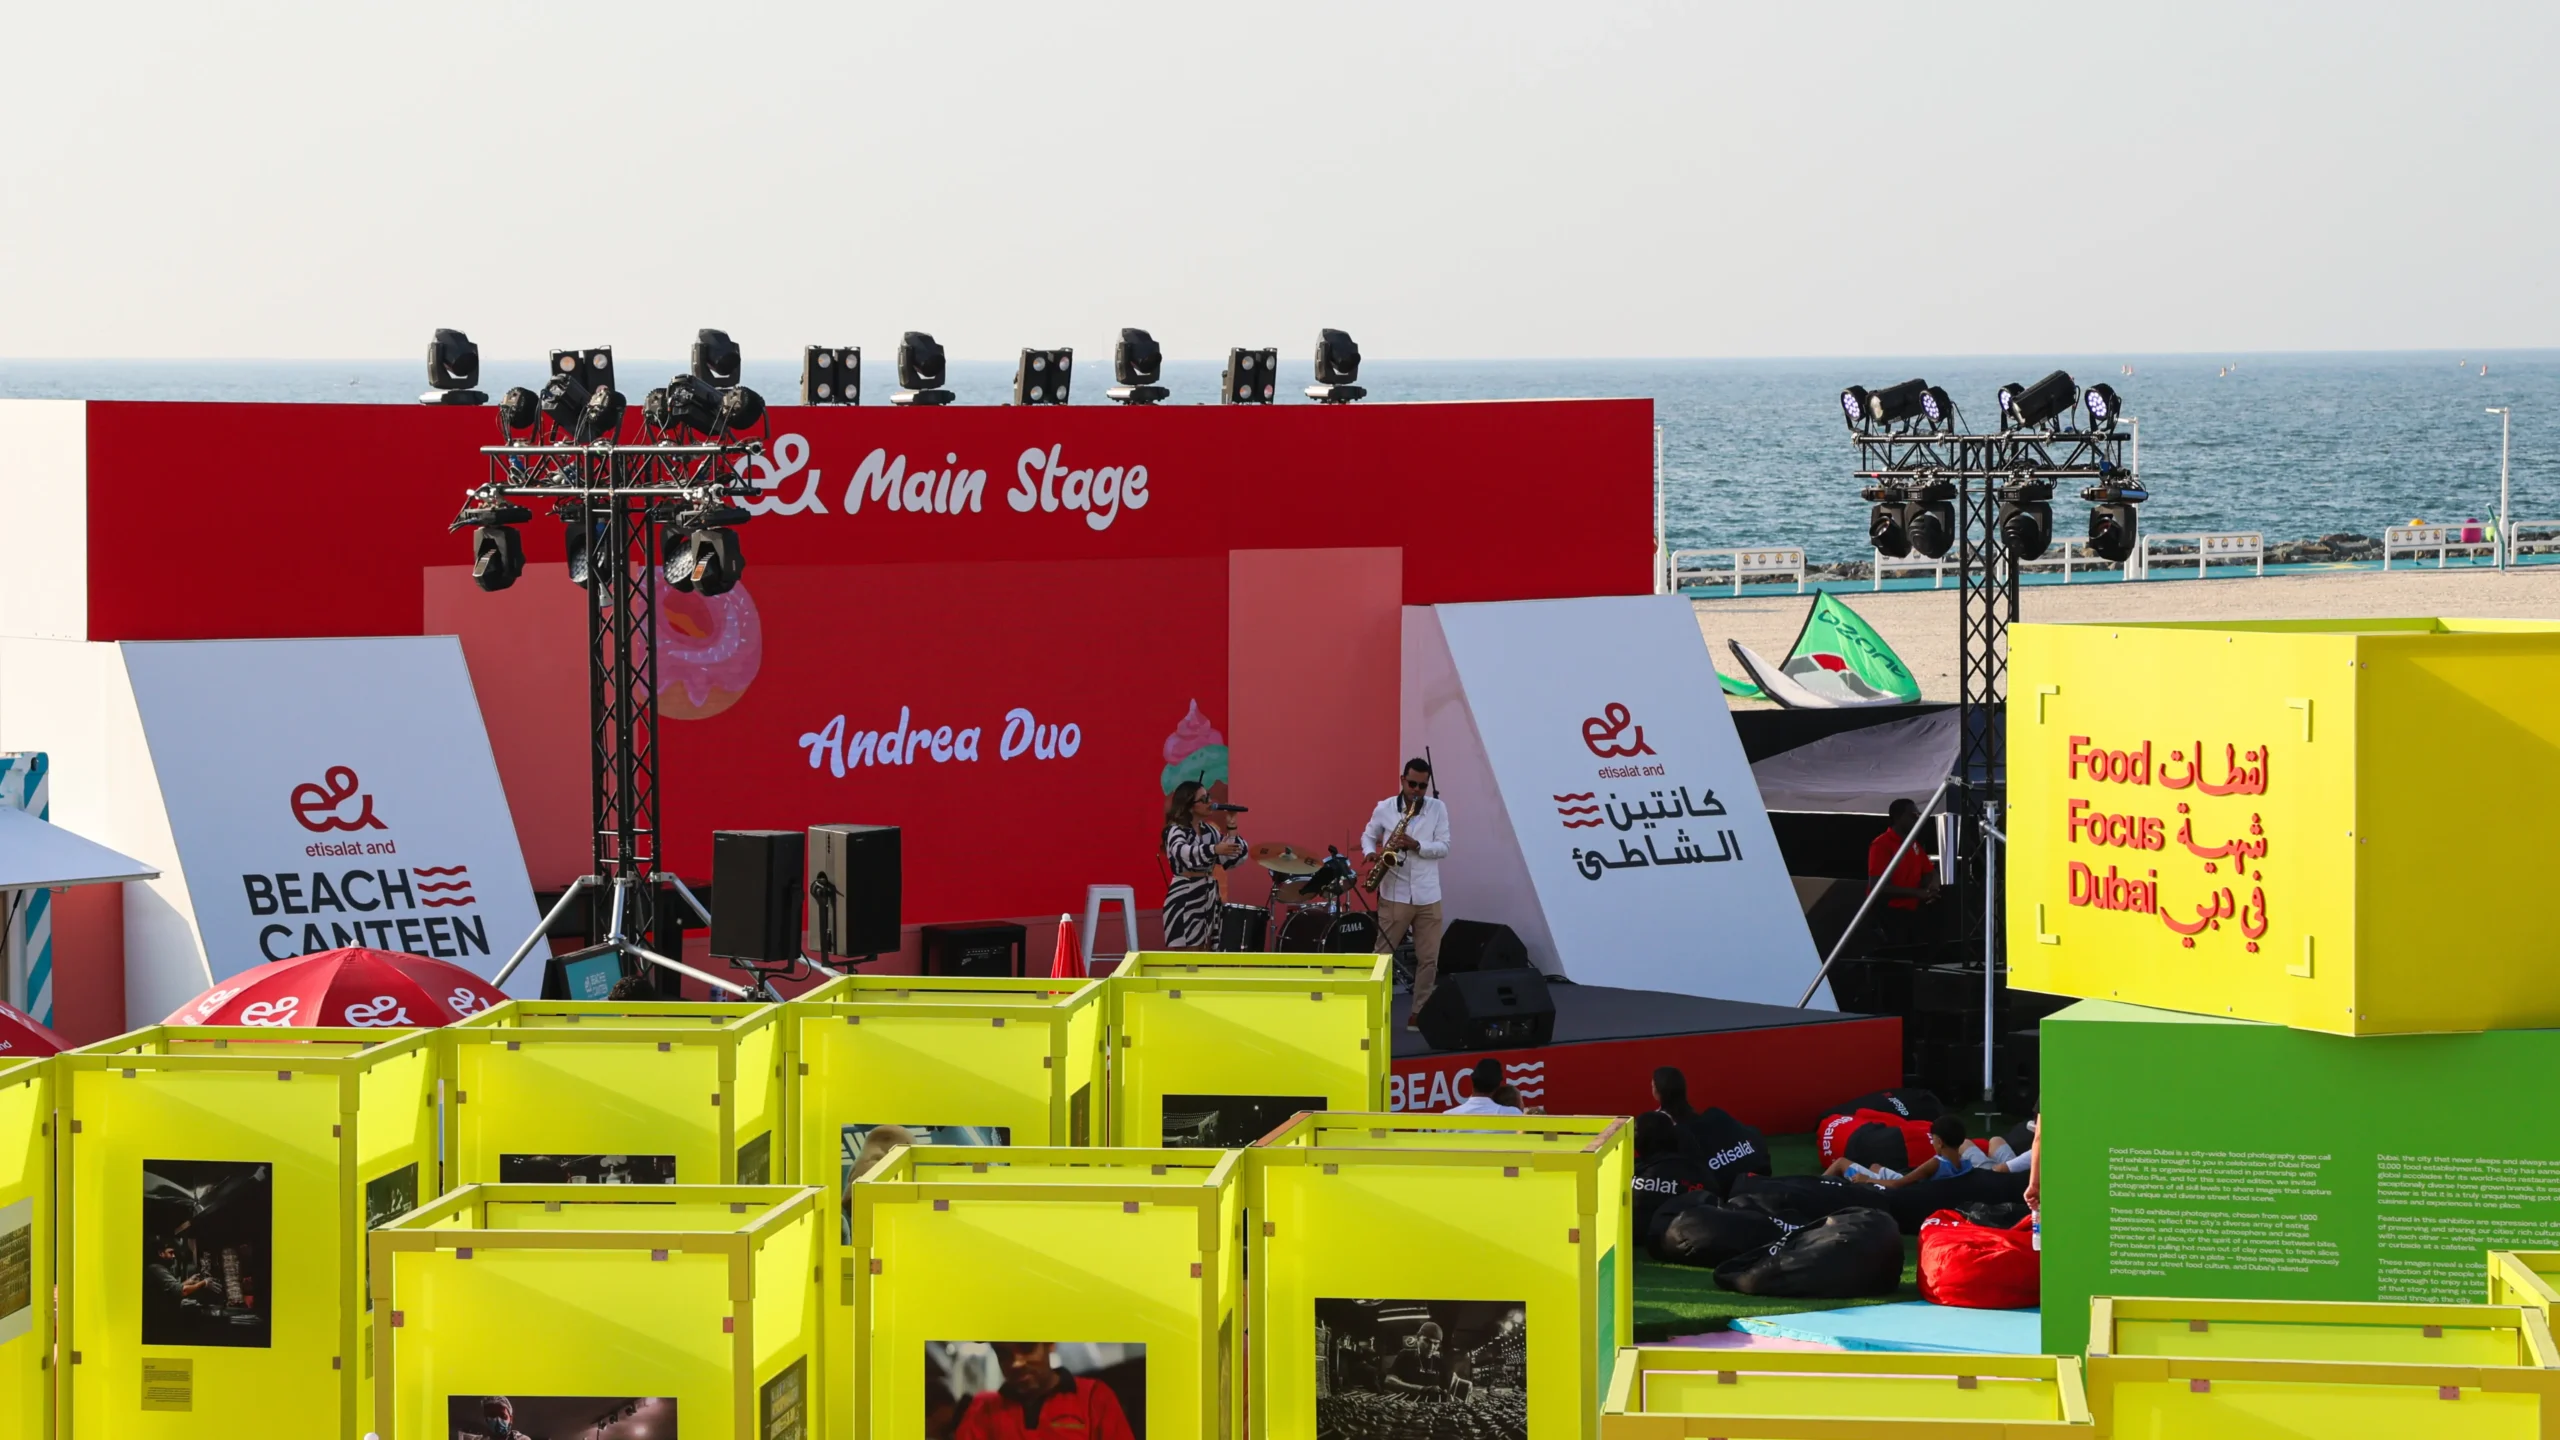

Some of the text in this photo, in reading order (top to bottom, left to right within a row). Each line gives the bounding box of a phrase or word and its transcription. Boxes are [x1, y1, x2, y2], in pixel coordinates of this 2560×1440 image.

[844, 447, 987, 515] Main
[1007, 443, 1149, 531] Stage
[799, 705, 1081, 778] Andrea Duo
[2068, 735, 2151, 785] Food
[1598, 763, 1665, 779] etisalat and
[2158, 740, 2268, 796] لقطات
[1605, 786, 1727, 832] كانتين
[2068, 798, 2165, 851] Focus
[305, 839, 395, 857] etisalat and
[2176, 802, 2268, 874] شهية
[243, 867, 416, 916] BEACH
[2068, 861, 2158, 915] Dubai
[2160, 870, 2268, 953] في دبي
[259, 914, 490, 962] CANTEEN
[0, 1039, 13, 1051] nd
[1391, 1068, 1474, 1112] BEAC
[1708, 1139, 1755, 1170] etisalat
[1631, 1175, 1678, 1194] isalat
